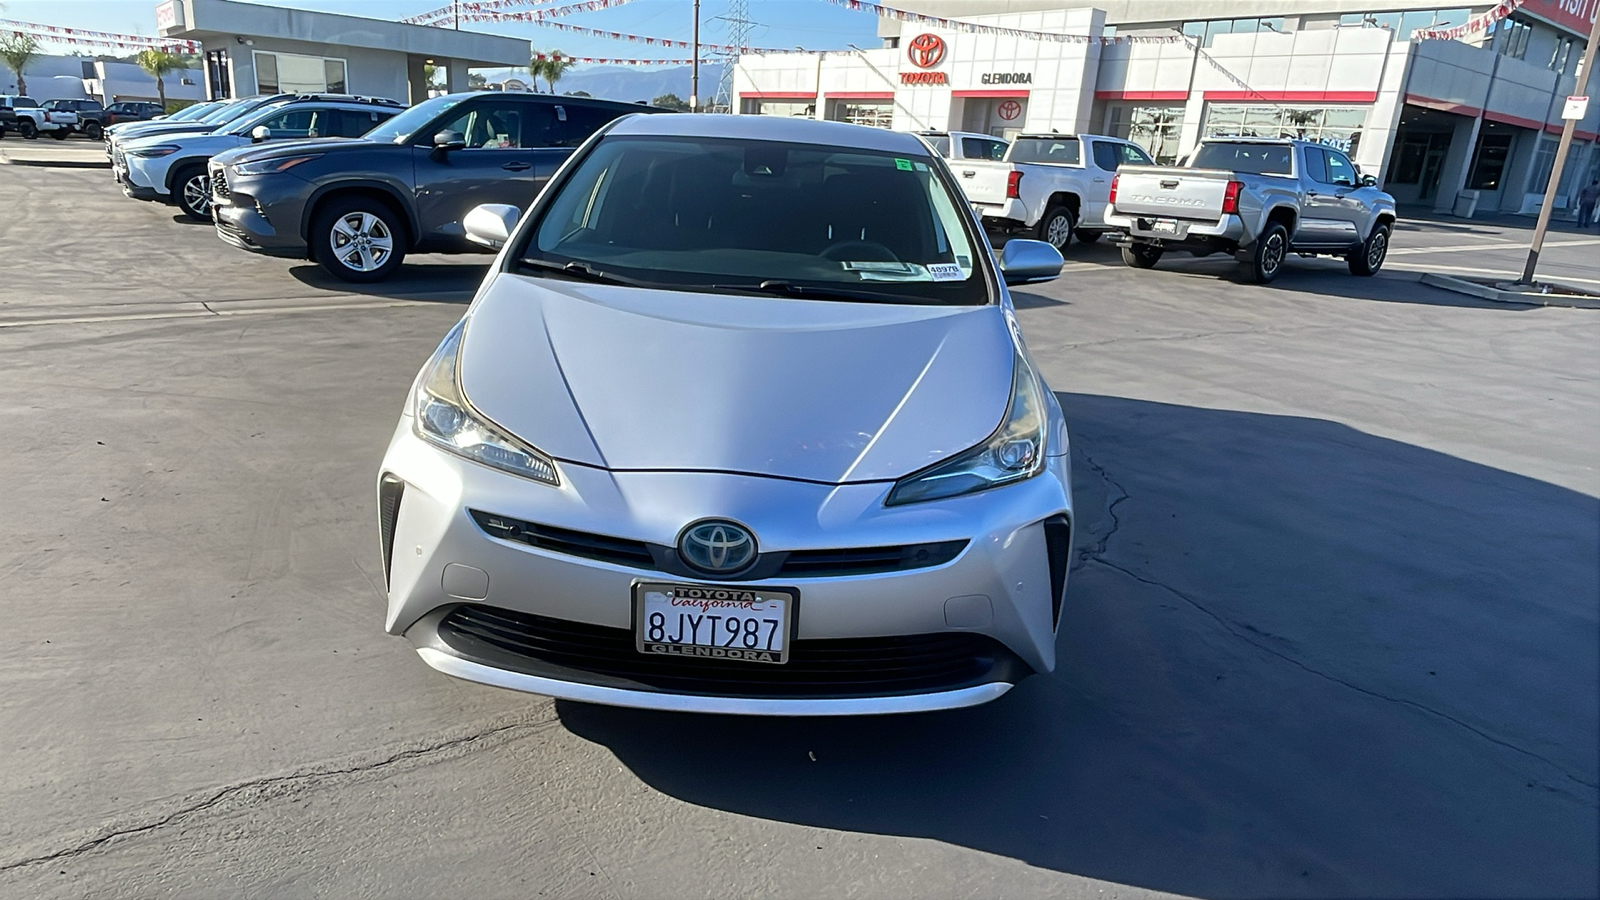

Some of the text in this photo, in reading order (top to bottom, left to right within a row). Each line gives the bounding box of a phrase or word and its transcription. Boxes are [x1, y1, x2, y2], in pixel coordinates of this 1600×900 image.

[899, 72, 948, 86] TOYOTA
[981, 73, 1032, 85] GLENDORA
[1321, 137, 1352, 153] SALE
[1131, 194, 1206, 208] TACOMA
[675, 588, 754, 601] TOYOTA
[649, 612, 778, 650] 8JYT987
[651, 644, 773, 662] GLENDORA
